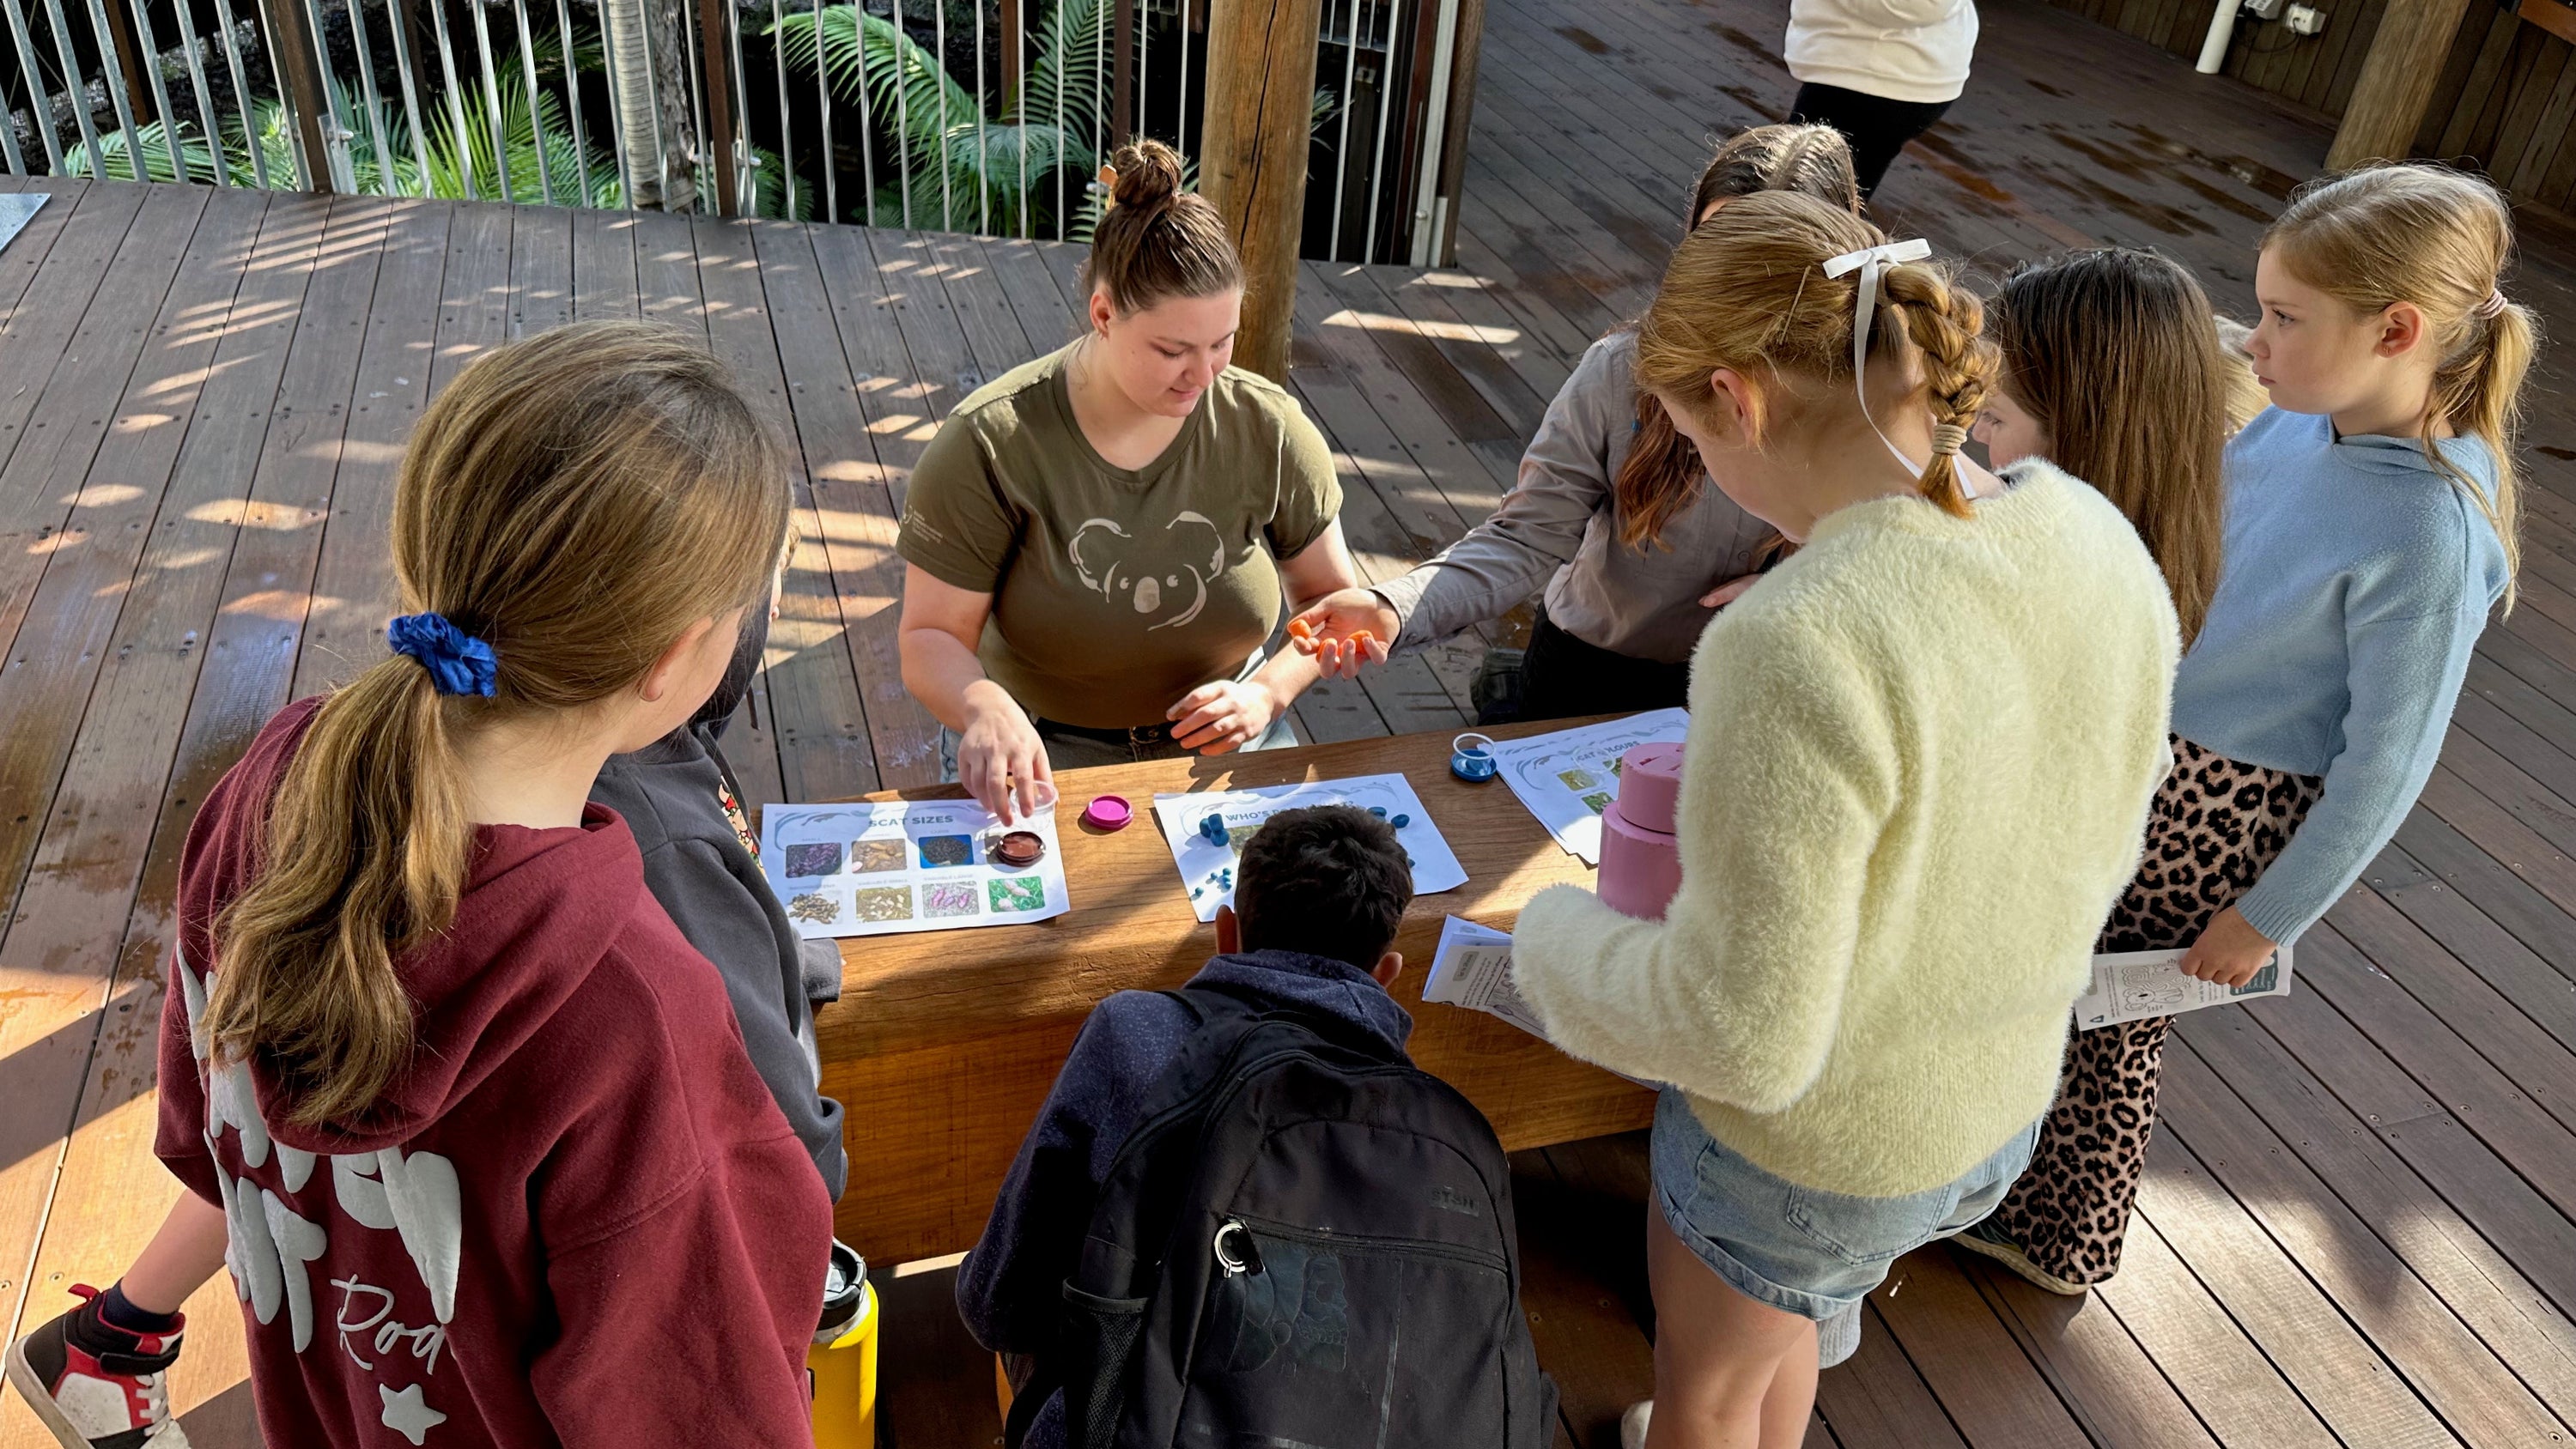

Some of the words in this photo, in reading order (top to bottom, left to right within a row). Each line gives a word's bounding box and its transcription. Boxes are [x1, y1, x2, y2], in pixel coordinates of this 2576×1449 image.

[868, 817, 907, 828] SCAT
[912, 815, 954, 825] SIZES
[1225, 810, 1270, 822] WHO'S
